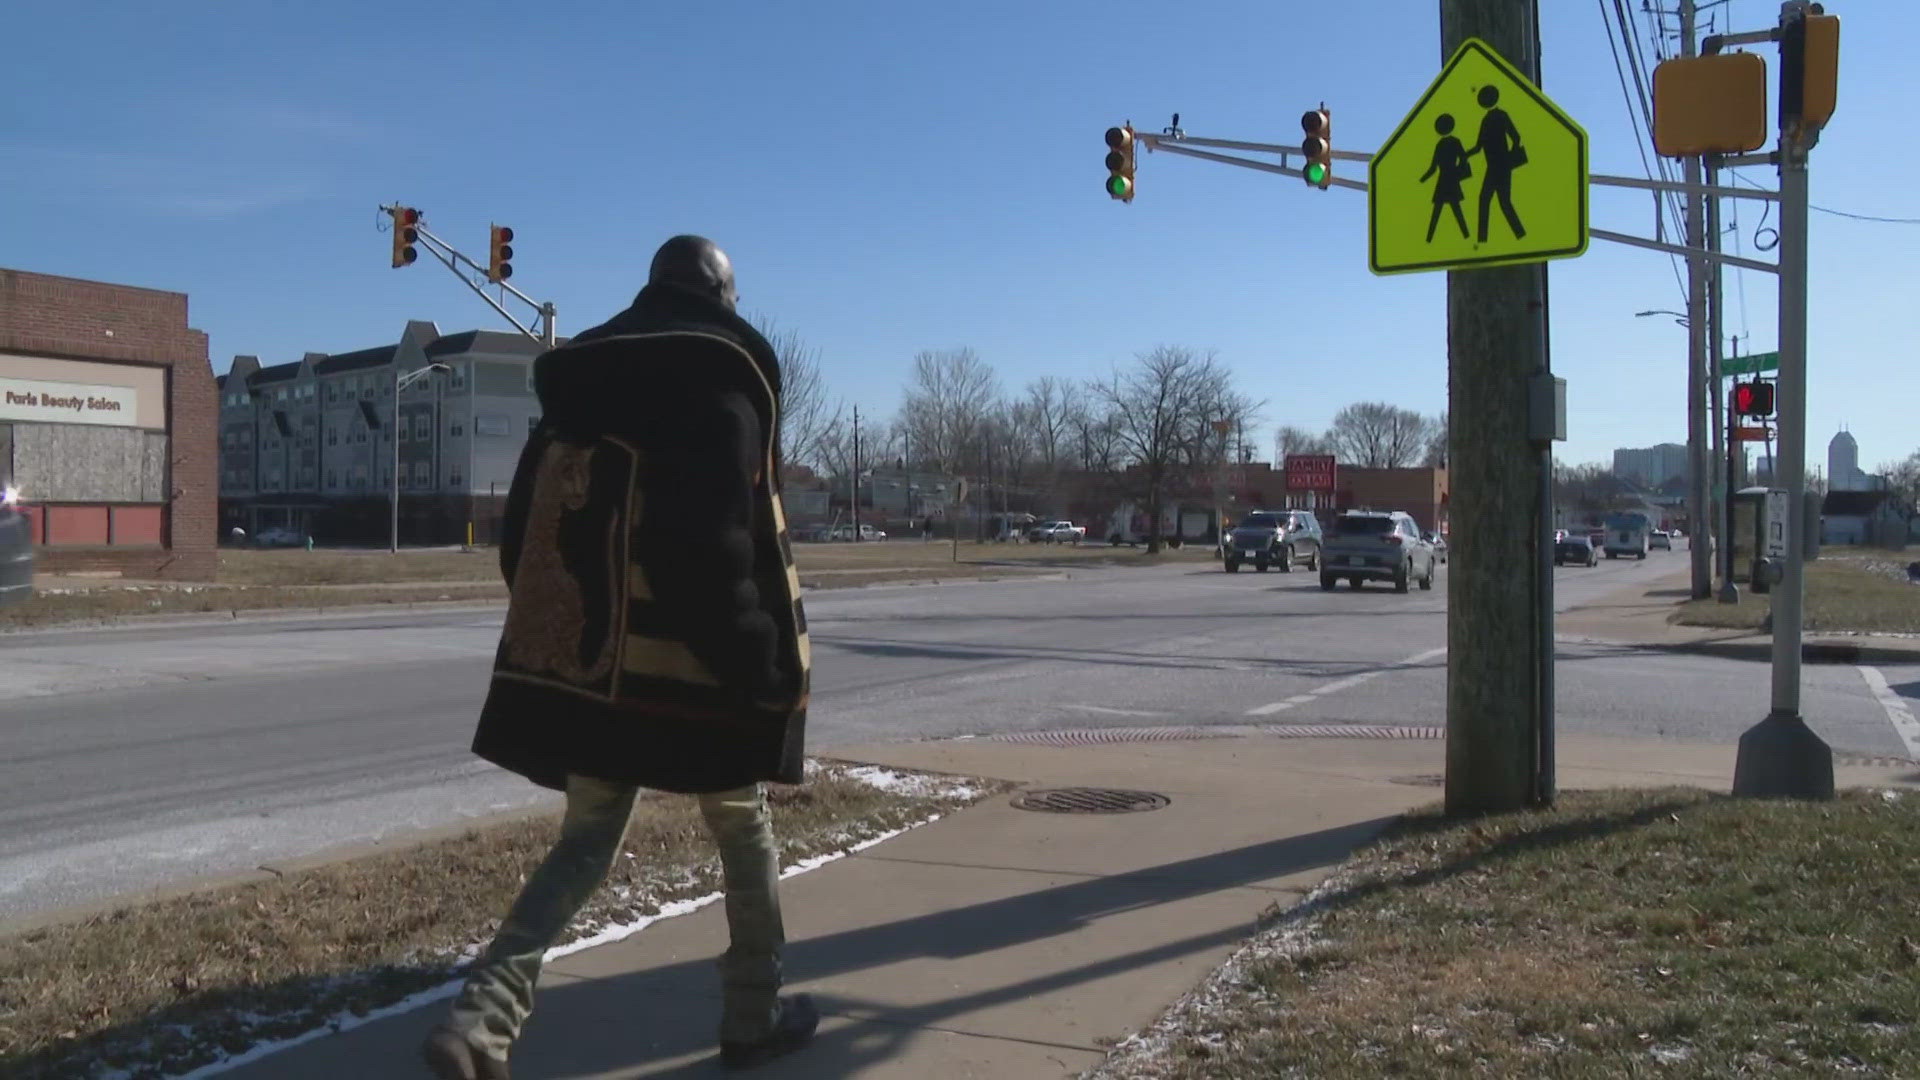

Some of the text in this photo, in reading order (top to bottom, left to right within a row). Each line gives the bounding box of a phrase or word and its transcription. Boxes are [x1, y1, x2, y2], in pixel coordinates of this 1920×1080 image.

[6, 391, 121, 412] Paris Beauty Salon
